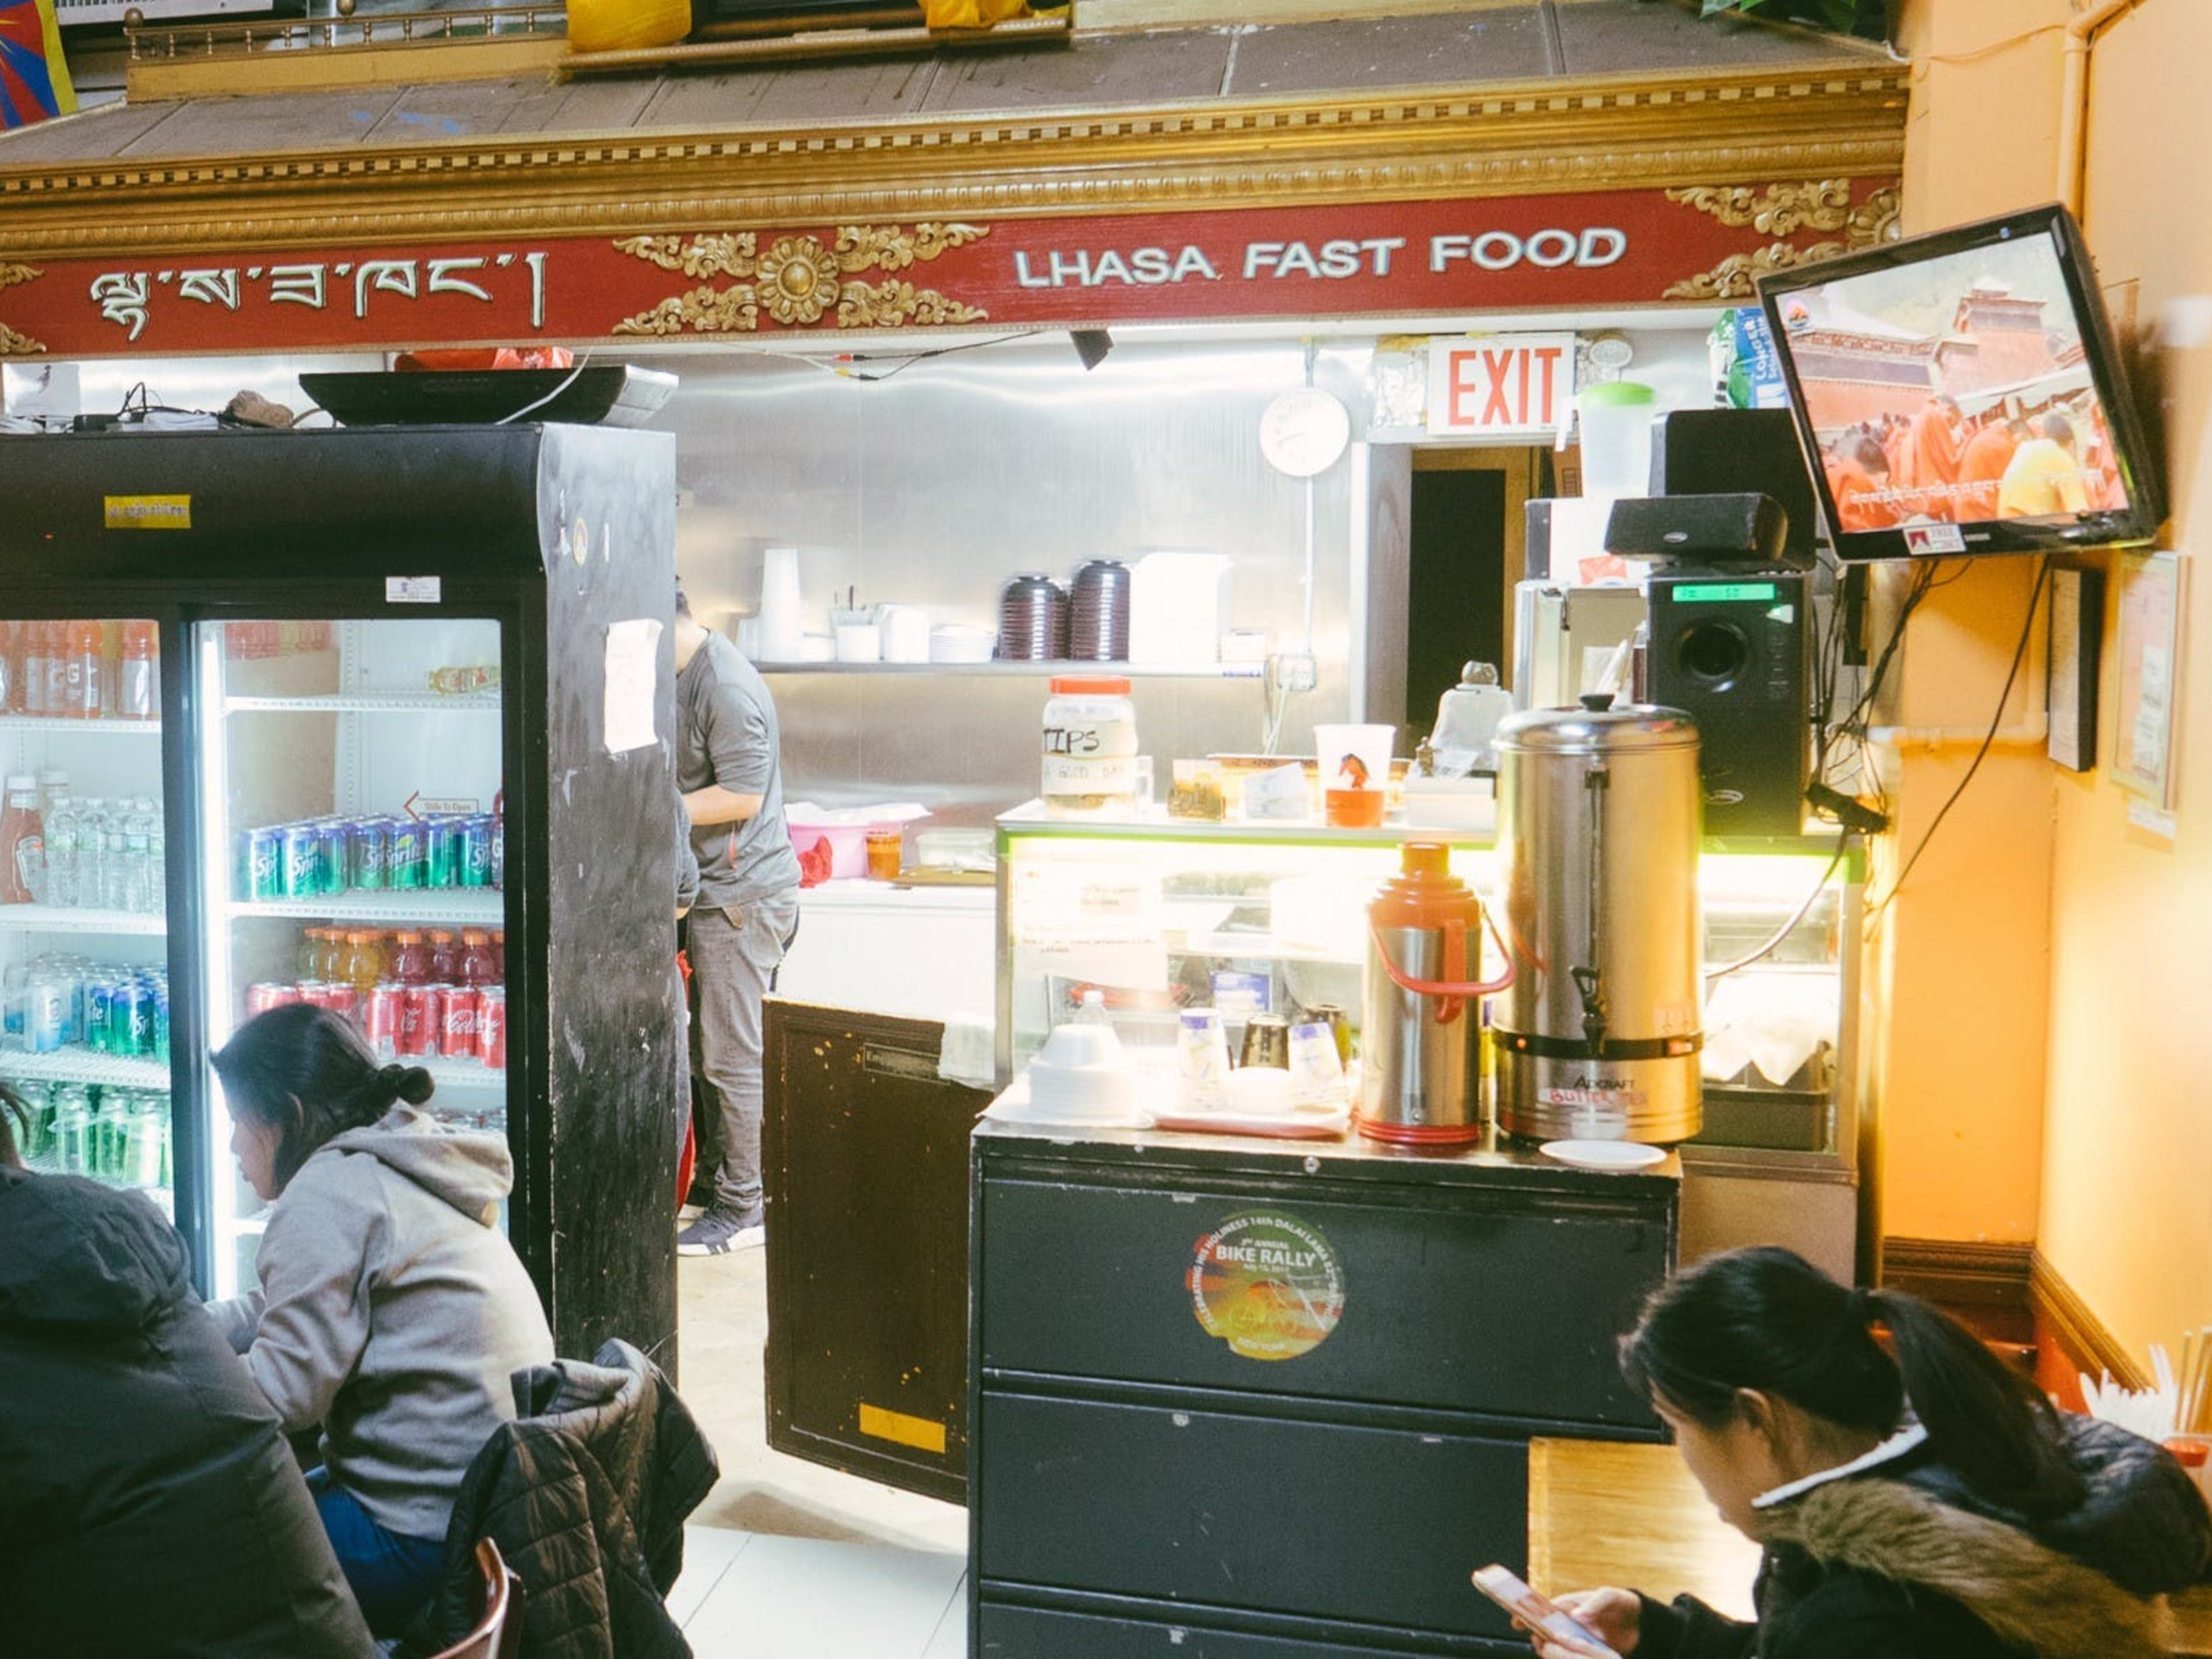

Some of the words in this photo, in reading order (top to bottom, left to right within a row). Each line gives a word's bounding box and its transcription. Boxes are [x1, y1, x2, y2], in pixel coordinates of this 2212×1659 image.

[1013, 244, 1217, 289] LHASA
[1242, 237, 1407, 280] FAST
[1429, 226, 1628, 274] FOOD
[1743, 319, 1770, 380] LONGER
[1448, 347, 1562, 427] EXIT
[1043, 728, 1100, 754] TIPS
[1216, 1244, 1257, 1263] BIKE
[1260, 1248, 1316, 1268] RALLY
